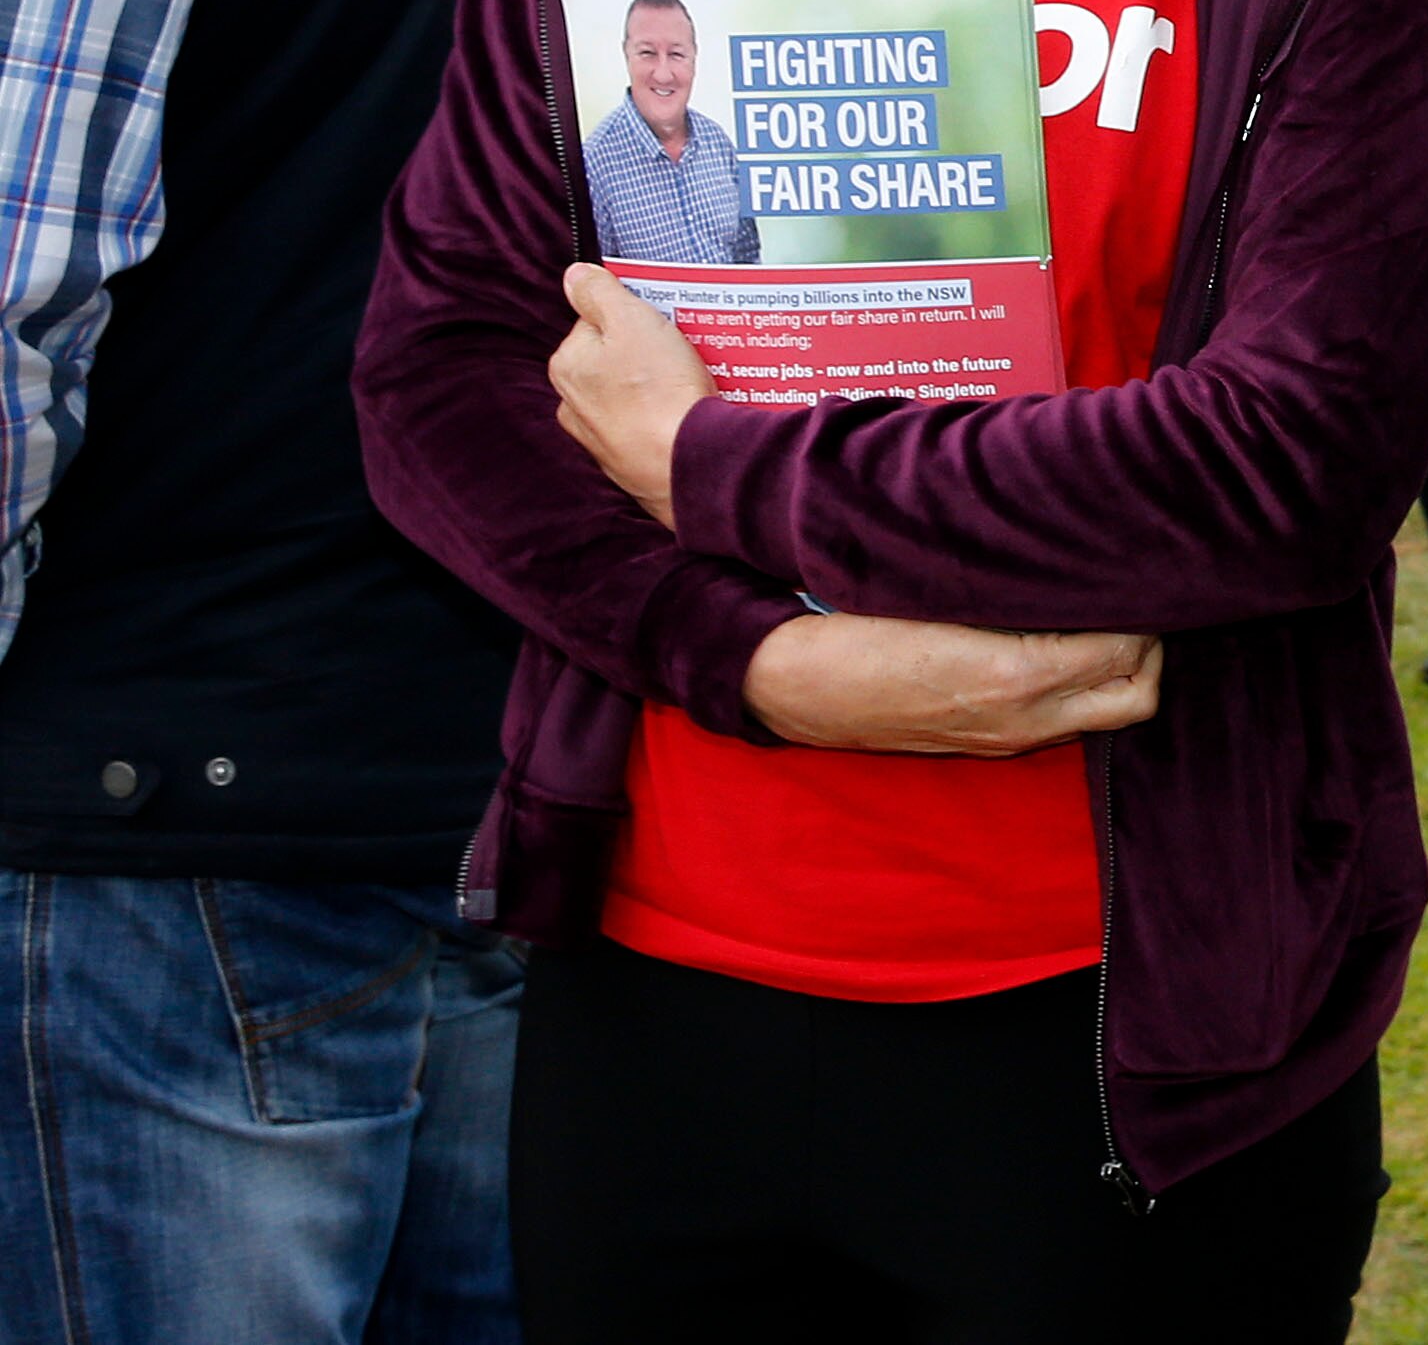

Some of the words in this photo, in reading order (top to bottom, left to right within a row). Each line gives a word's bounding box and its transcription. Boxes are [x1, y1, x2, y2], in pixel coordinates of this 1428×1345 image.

[740, 36, 938, 86] FIGHTING
[745, 102, 828, 149] FOR
[836, 100, 928, 147] OUR
[750, 165, 841, 211] FAIR
[850, 160, 996, 210] SHARE
[643, 288, 677, 302] Upper
[679, 289, 720, 303] Hunter
[723, 291, 734, 303] is
[738, 292, 800, 307] pumping
[803, 290, 859, 304] billions
[863, 289, 893, 302] into
[898, 288, 923, 302] the
[927, 286, 967, 301] NSW
[677, 310, 695, 324] but
[696, 314, 714, 325] we
[716, 312, 751, 326] aren't
[753, 313, 800, 329] getting
[803, 315, 828, 326] our
[831, 312, 854, 326] fair
[858, 311, 899, 325] share
[902, 309, 916, 323] in
[920, 309, 968, 323] return.
[971, 307, 976, 320] I
[979, 305, 1006, 319] will
[732, 365, 779, 378] secure
[780, 363, 813, 381] jobs
[827, 364, 861, 377] now
[864, 361, 894, 376] and
[897, 360, 929, 375] into
[933, 359, 959, 373] the
[962, 357, 1012, 372] future
[750, 388, 817, 407] including
[888, 386, 916, 399] the
[918, 383, 996, 401] Singleton
